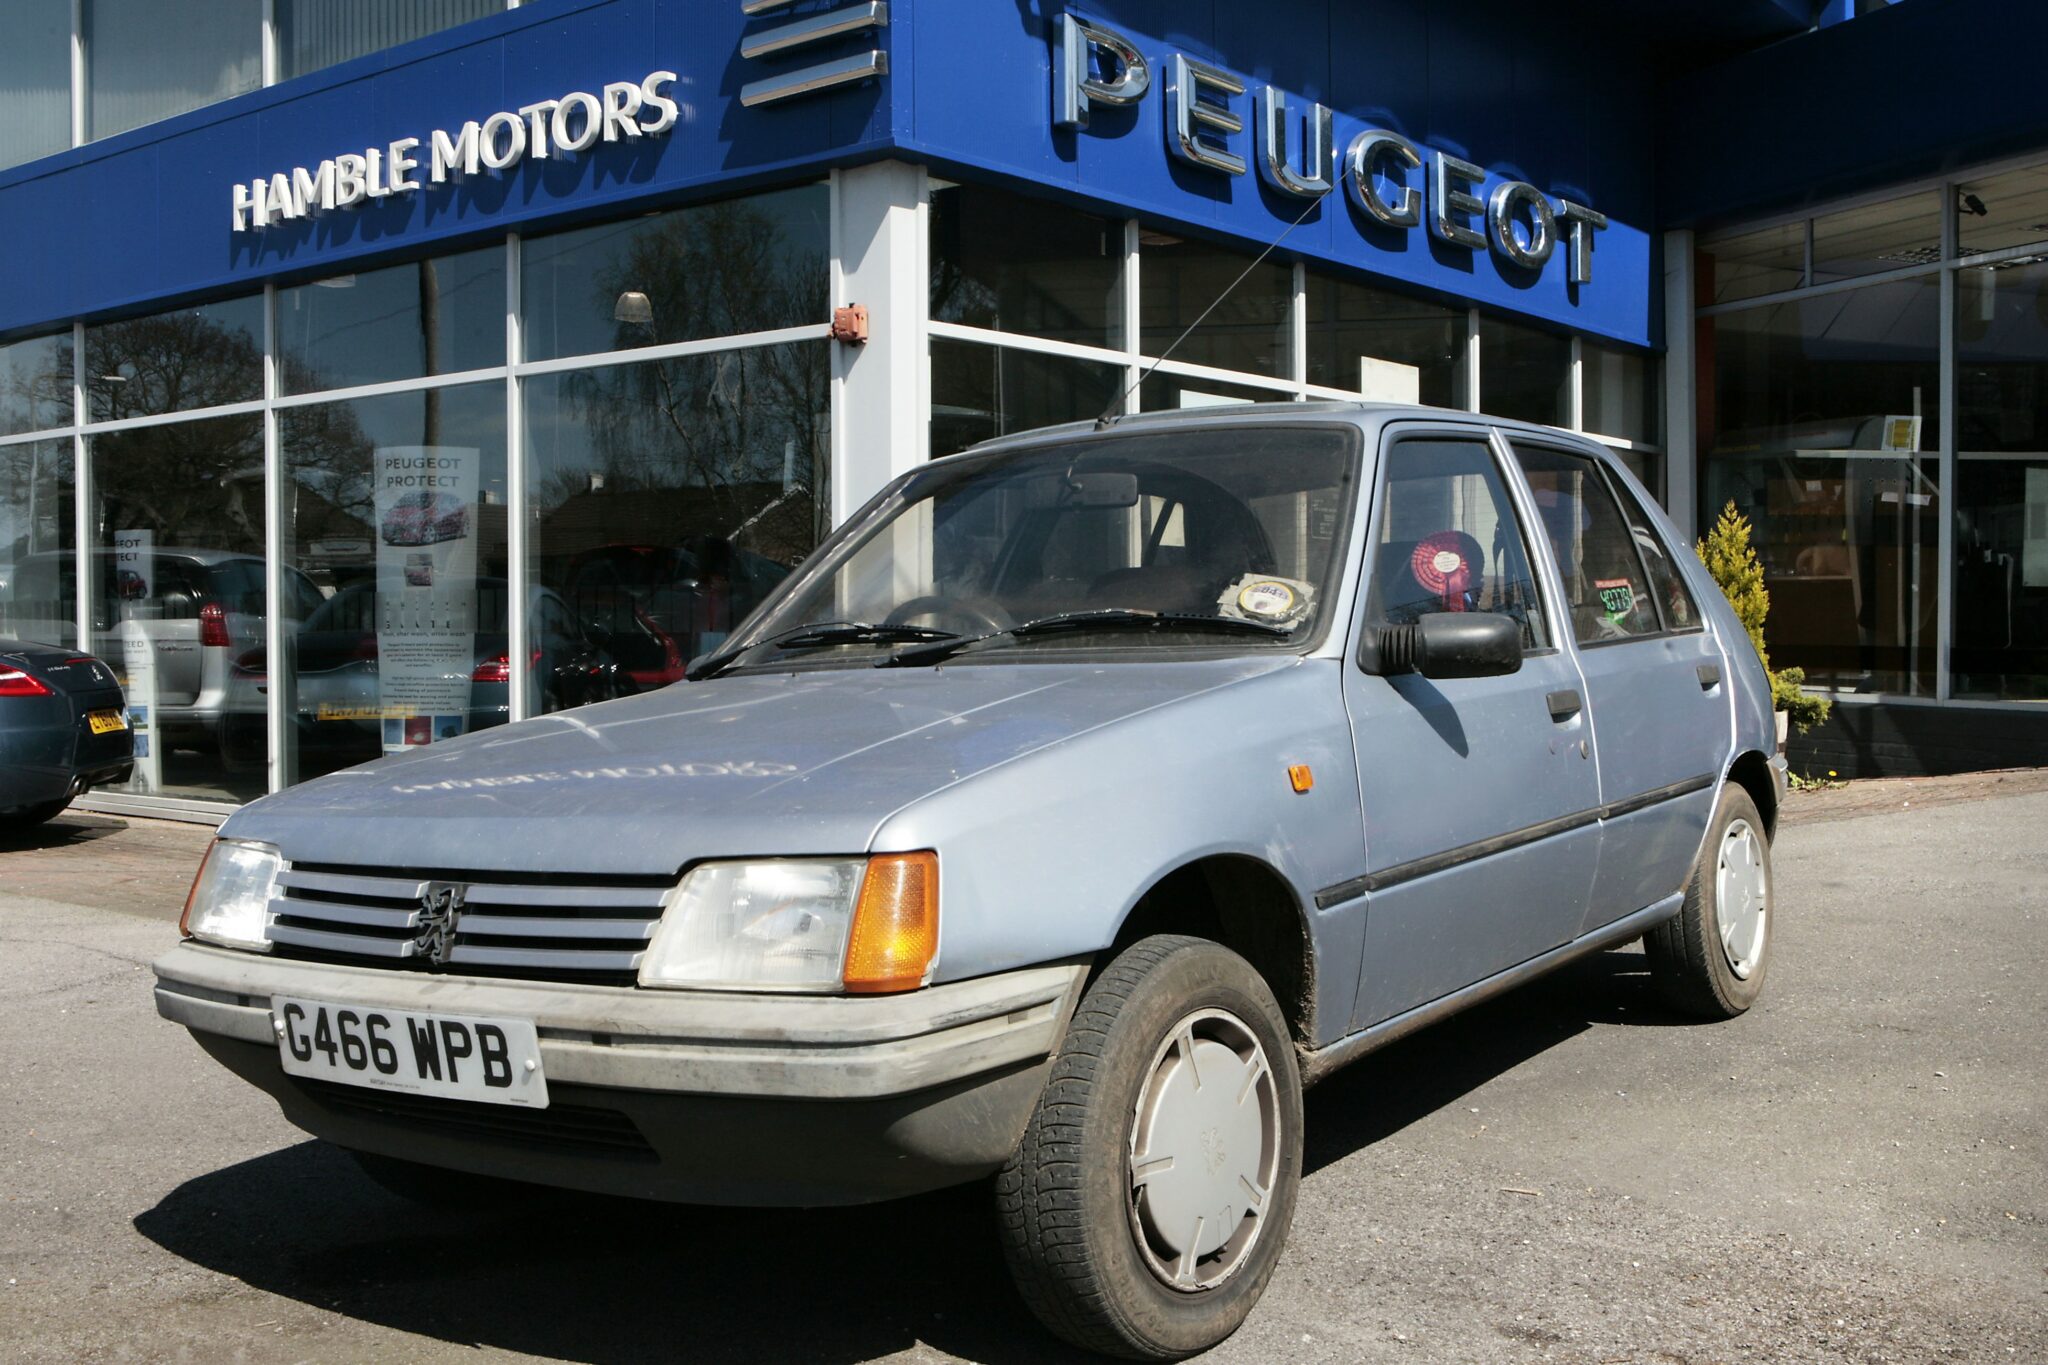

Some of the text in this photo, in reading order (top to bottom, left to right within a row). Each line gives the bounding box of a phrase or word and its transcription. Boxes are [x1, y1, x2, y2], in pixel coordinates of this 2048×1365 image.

[232, 70, 679, 232] HAMBLE MOTORS
[1053, 12, 1608, 284] PEUGEOT
[385, 457, 462, 470] PEUGEOT
[387, 475, 460, 488] PROTECT
[283, 1002, 513, 1088] G466 WPB
